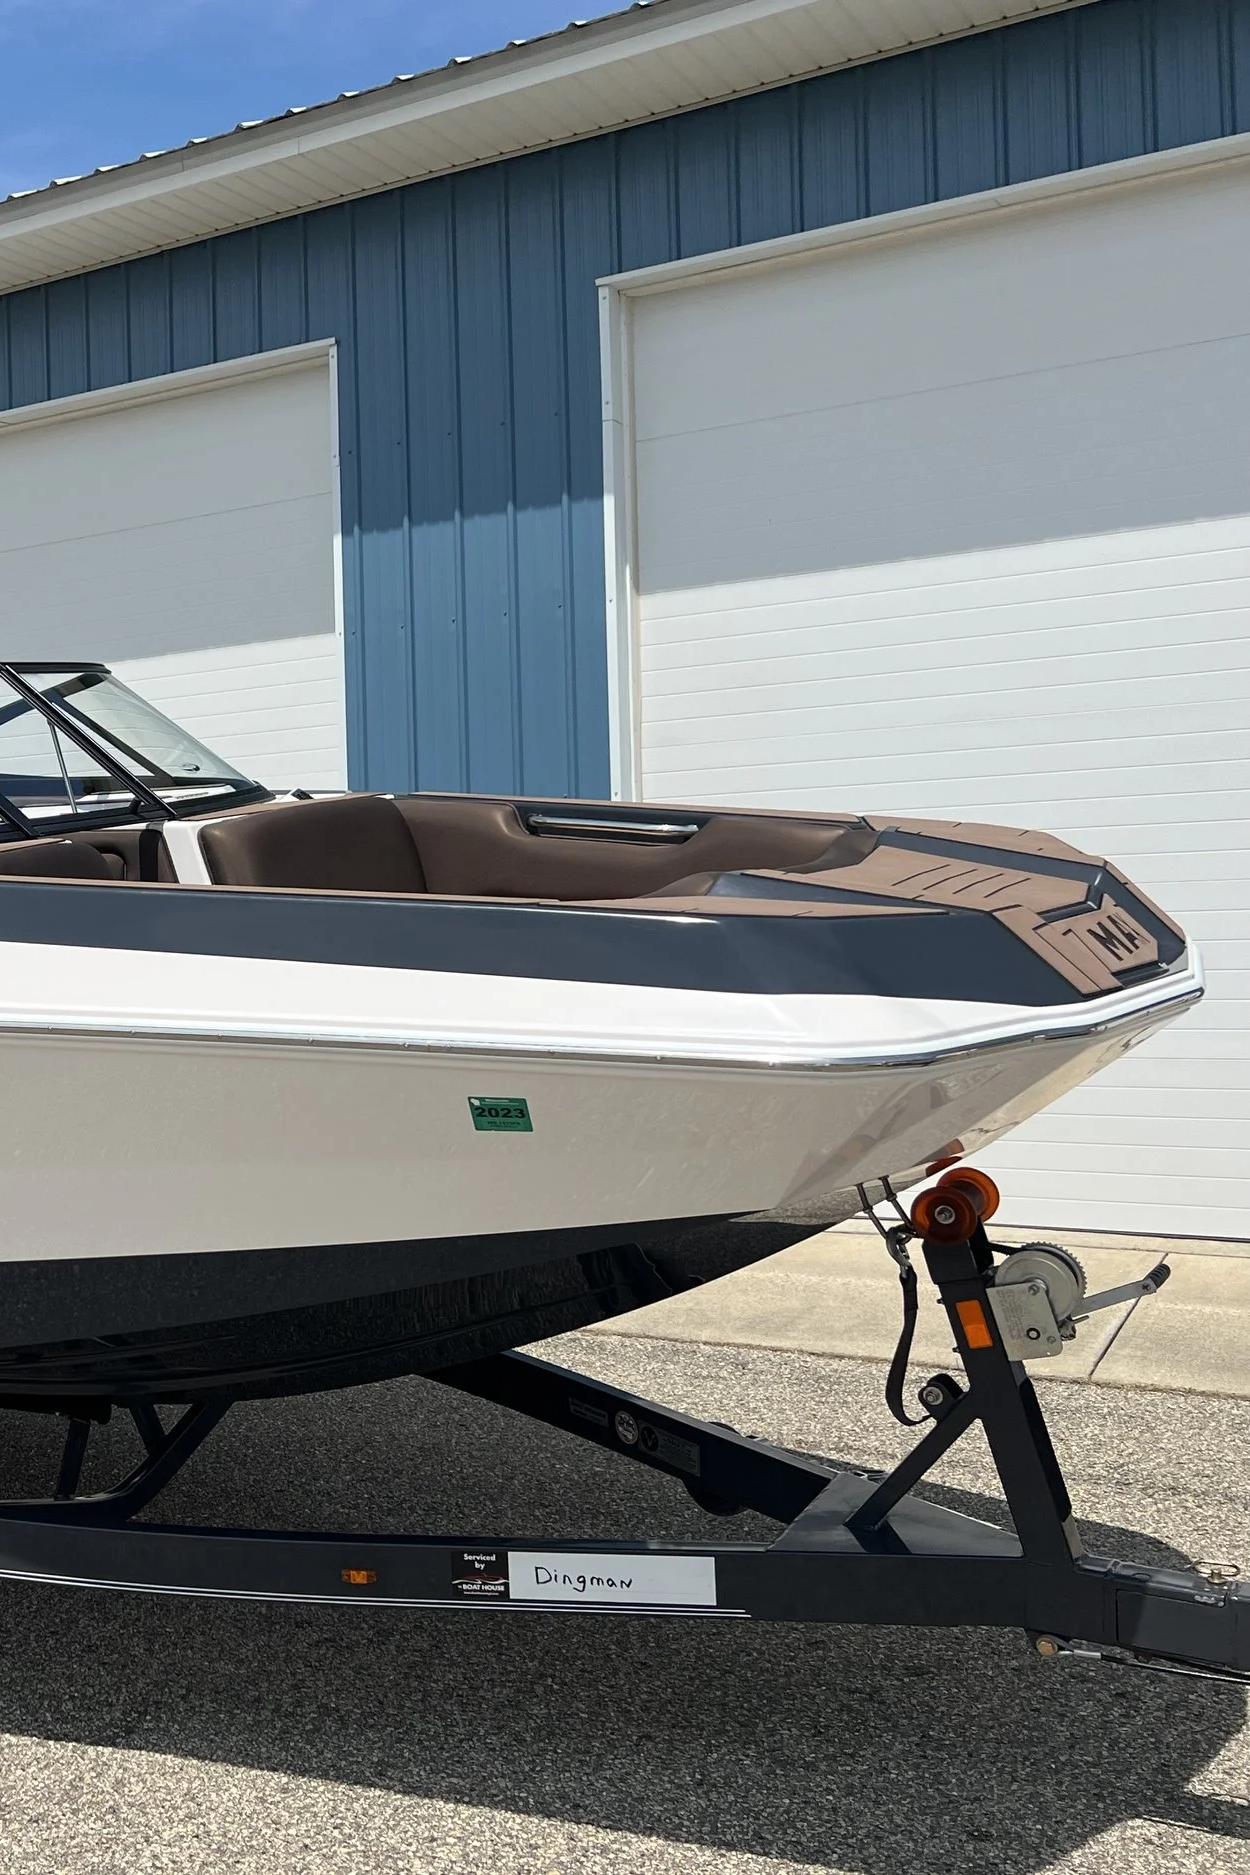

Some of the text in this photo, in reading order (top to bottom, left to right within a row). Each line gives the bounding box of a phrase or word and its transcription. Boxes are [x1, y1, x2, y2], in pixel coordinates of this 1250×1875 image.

[474, 1106, 526, 1119] 2023
[463, 1553, 496, 1561] Serviced
[474, 1560, 486, 1570] by
[534, 1566, 633, 1593] Dingman
[462, 1583, 481, 1591] BOAT
[481, 1584, 505, 1592] HOUSE
